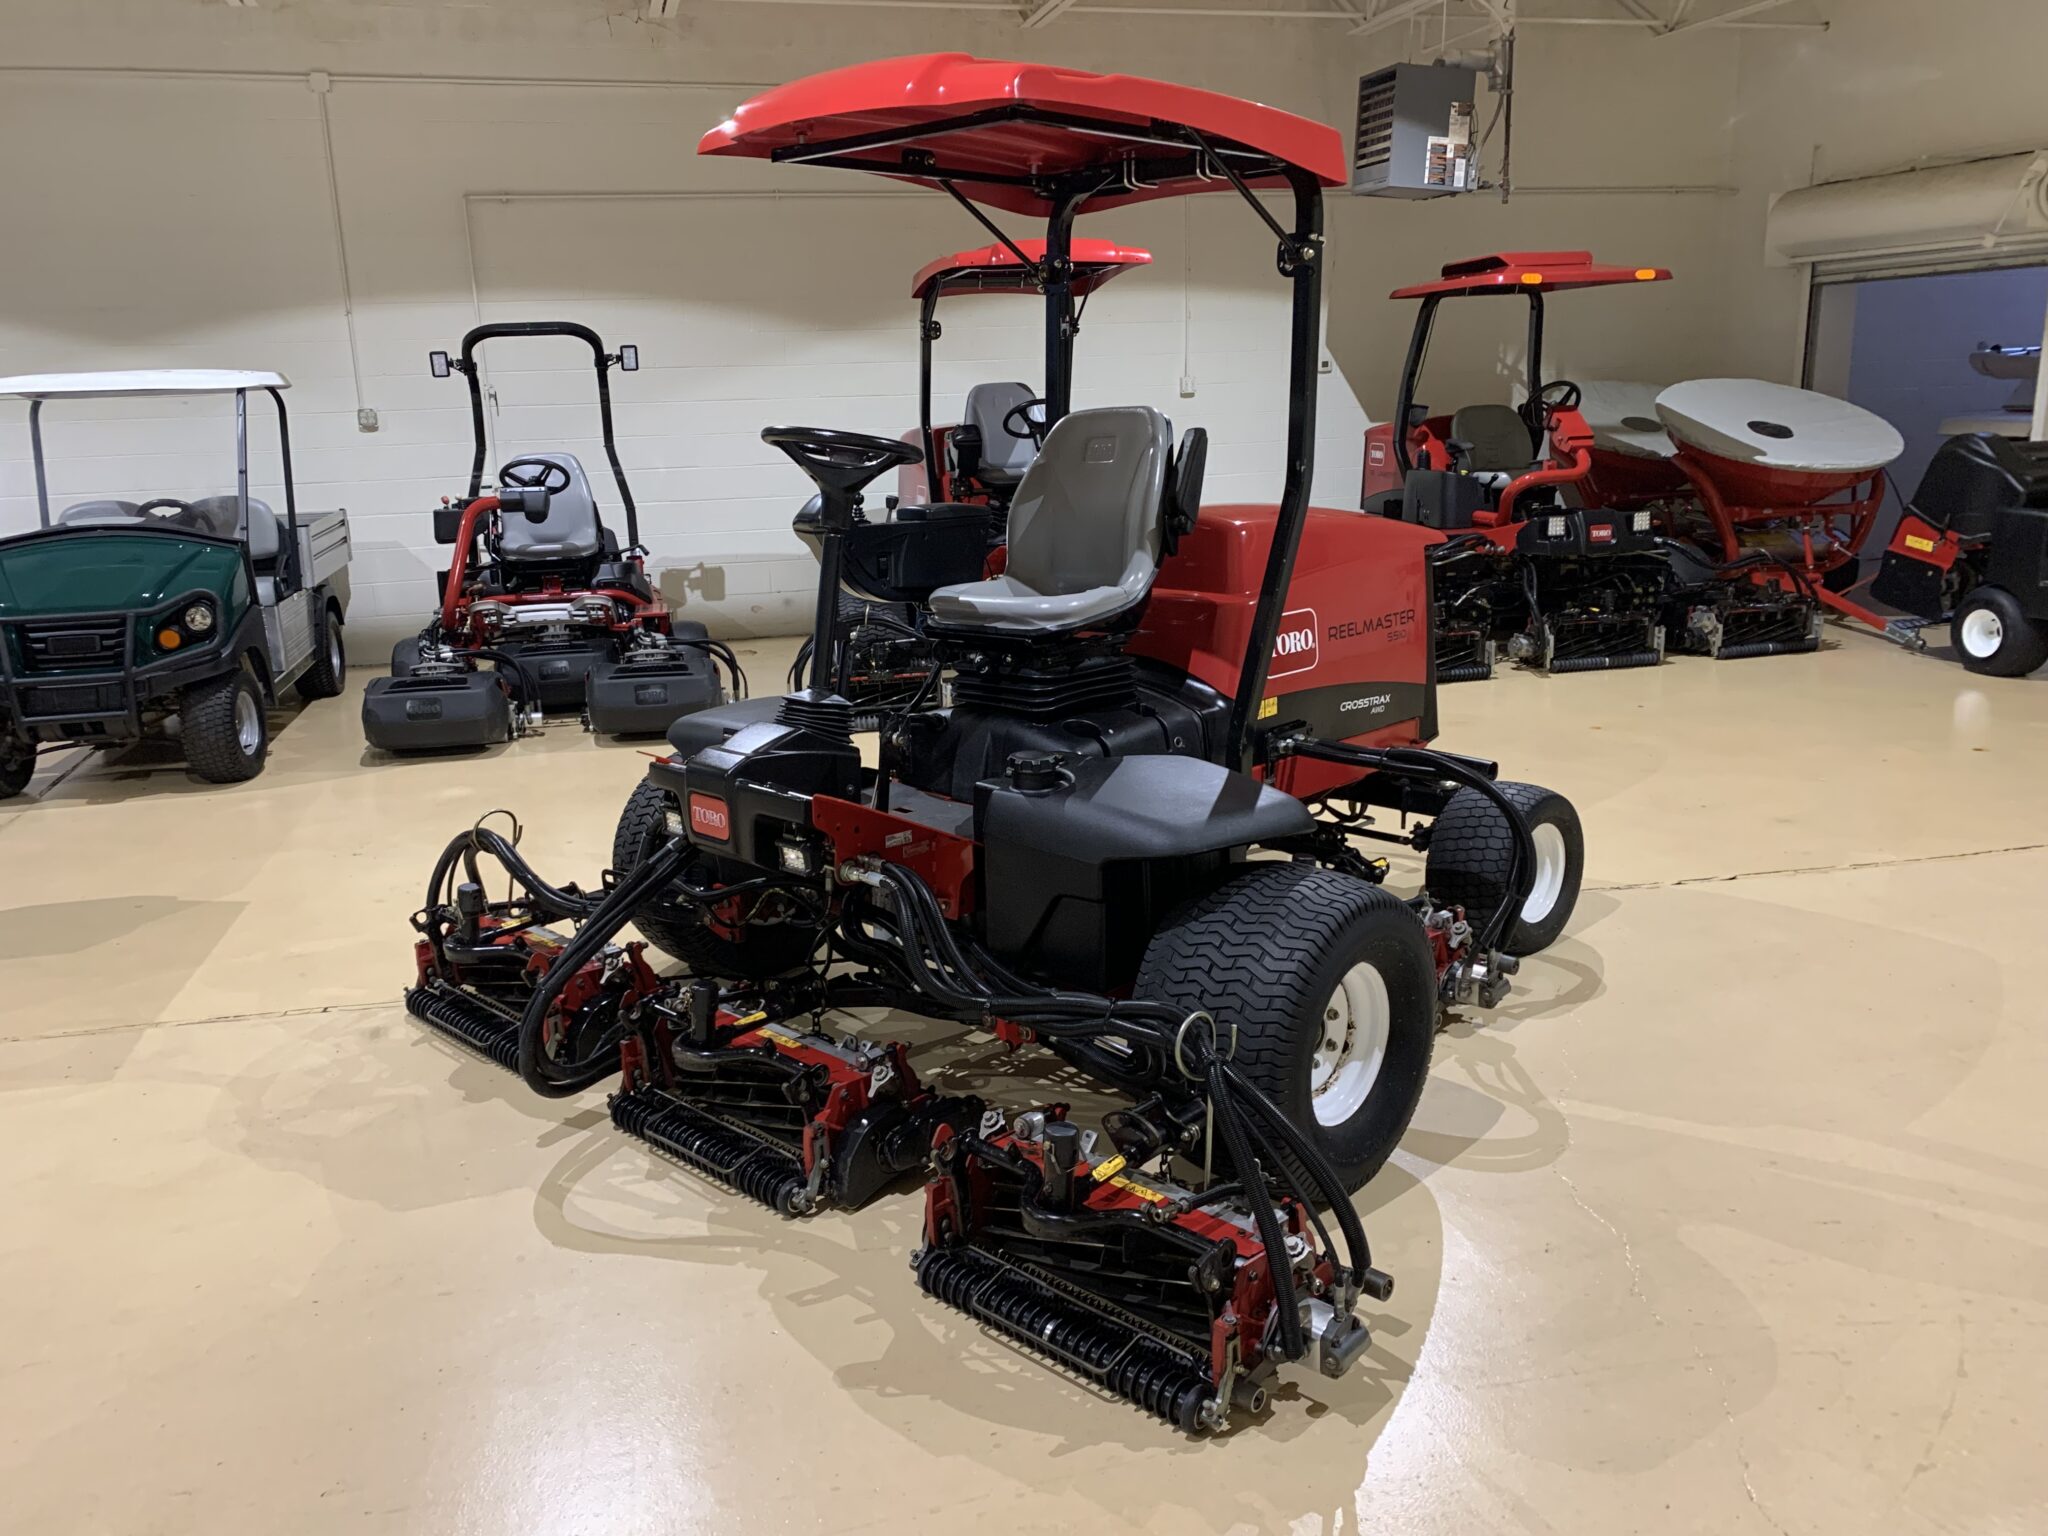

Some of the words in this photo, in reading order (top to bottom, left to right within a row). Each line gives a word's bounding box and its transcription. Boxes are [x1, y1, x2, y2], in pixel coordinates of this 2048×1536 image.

[1592, 529, 1611, 537] TORO
[1328, 609, 1415, 642] REELMASTER
[1340, 694, 1391, 711] CROSSTRAX
[1371, 705, 1385, 714] AWD
[692, 806, 726, 828] TORO
